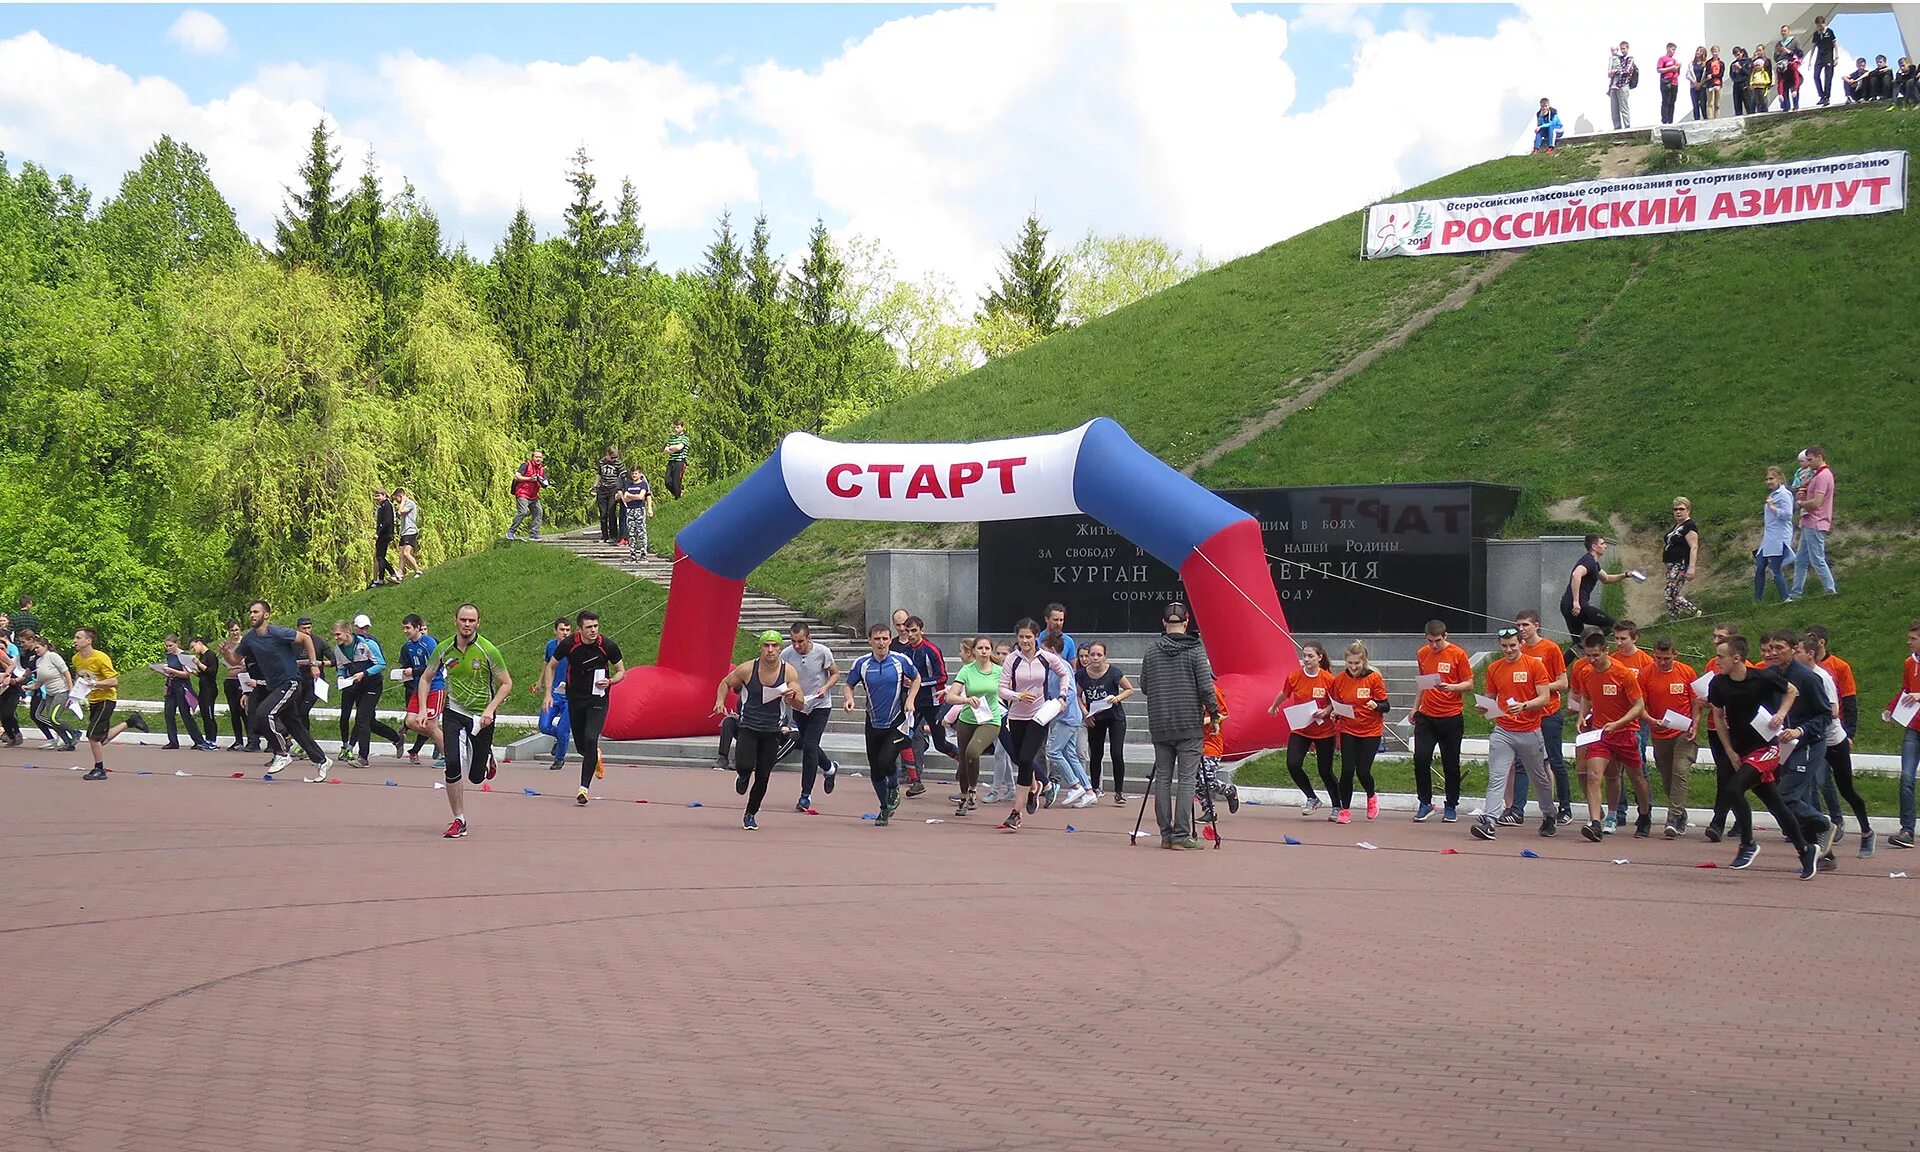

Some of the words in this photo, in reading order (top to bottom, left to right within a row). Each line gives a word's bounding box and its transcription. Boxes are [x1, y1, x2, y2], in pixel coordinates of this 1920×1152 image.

[1446, 195, 1529, 211] Всероссийские
[1531, 188, 1585, 203] массовые
[1588, 179, 1673, 196] соревнования
[1675, 177, 1690, 187] по
[1692, 168, 1775, 185] спортивному
[1777, 157, 1890, 178] ориентированию
[1441, 188, 1697, 245] РОССИЙСКИЙ
[1708, 177, 1890, 221] АЗИМУТ
[825, 456, 1027, 500] СТАРТ
[1301, 520, 1308, 530] В
[1322, 519, 1356, 530] БОЯХ
[1038, 548, 1052, 559] ЗА
[1066, 547, 1117, 559] СВОБОДУ
[1284, 541, 1328, 553] НАШЕЙ
[1053, 565, 1148, 584] КУРГАН
